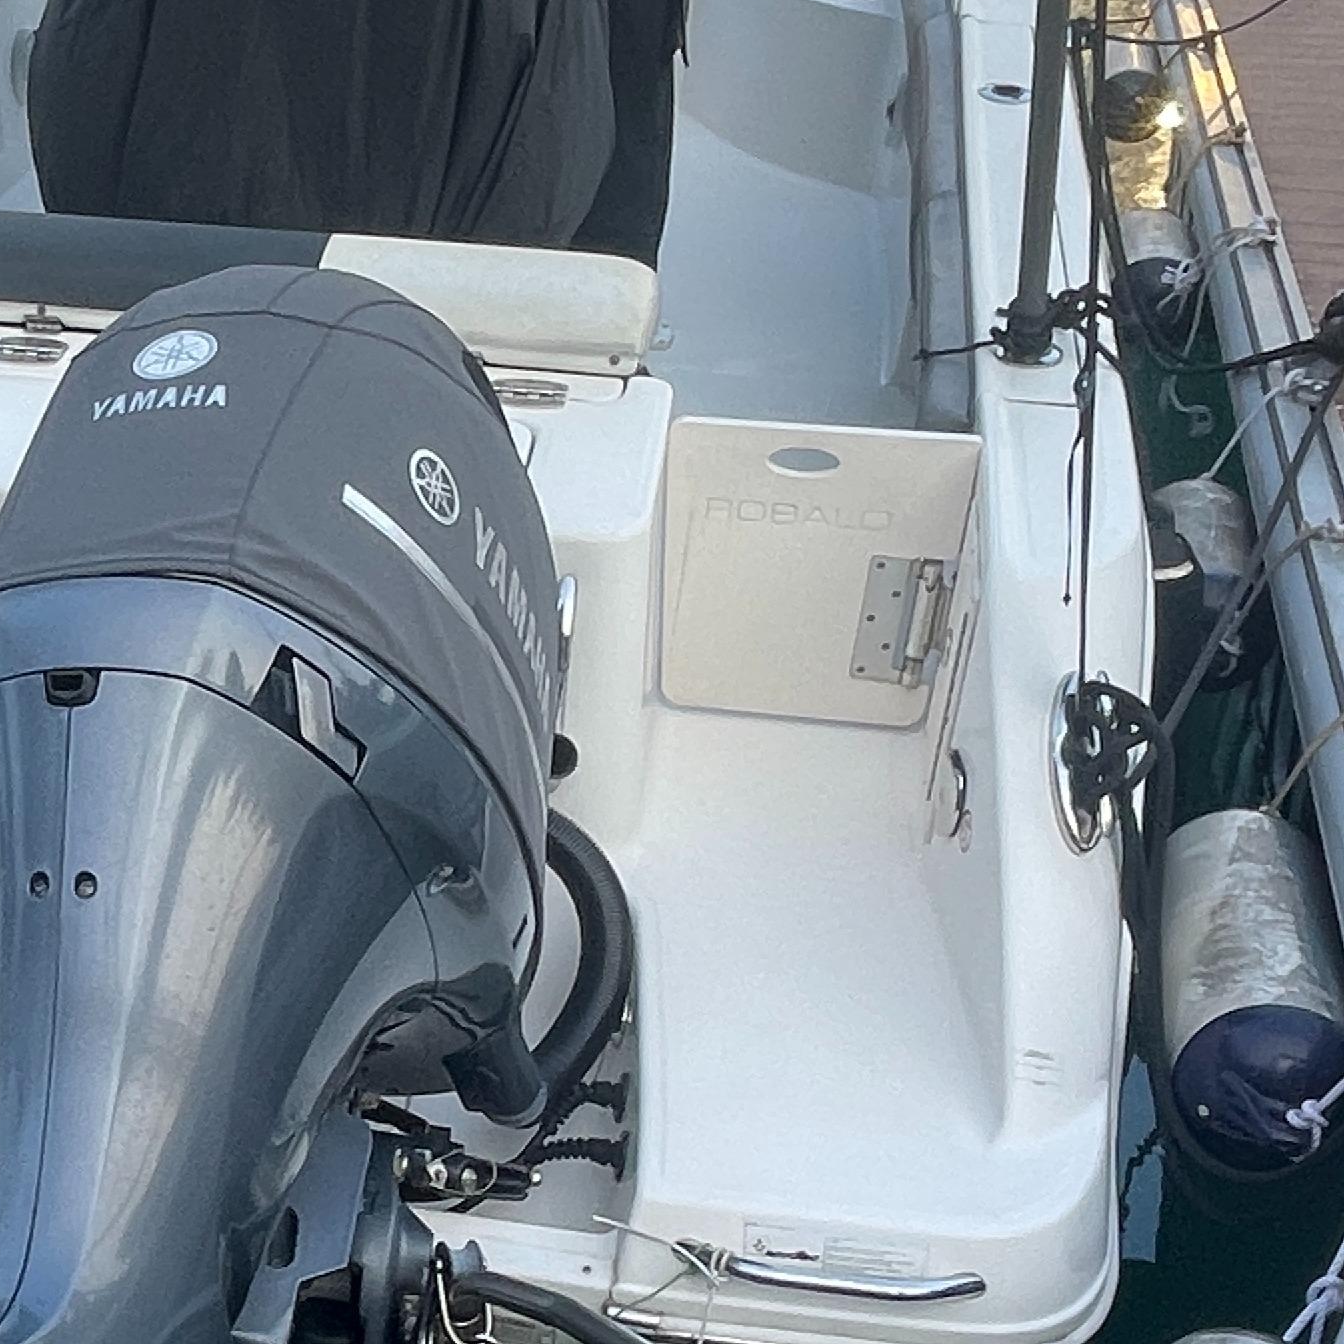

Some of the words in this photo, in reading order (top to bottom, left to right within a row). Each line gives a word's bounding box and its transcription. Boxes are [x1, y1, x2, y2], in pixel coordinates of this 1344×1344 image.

[92, 384, 226, 422] YAMAHA
[705, 497, 895, 532] ROBALO
[475, 506, 550, 734] YAMAHA
